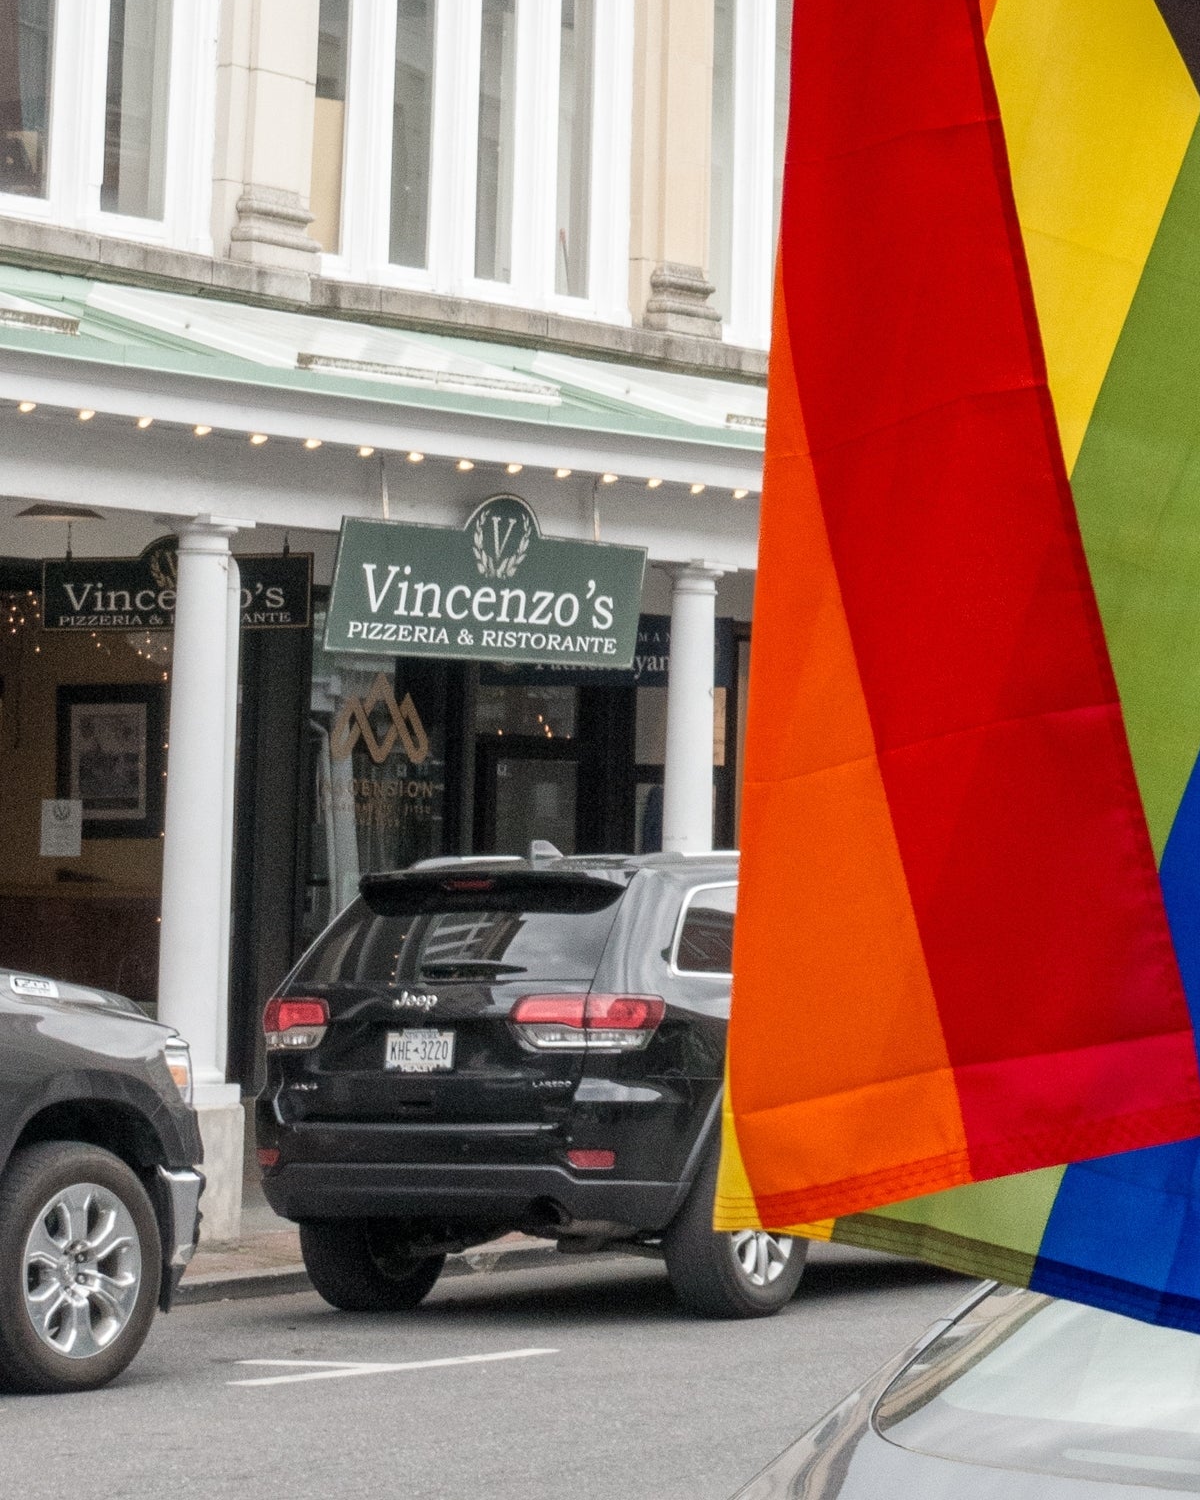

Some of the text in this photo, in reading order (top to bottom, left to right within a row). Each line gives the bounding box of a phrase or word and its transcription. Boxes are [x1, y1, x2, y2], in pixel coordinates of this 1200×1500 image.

[490, 515, 517, 560] V
[63, 582, 285, 612] Vinceo's
[362, 563, 614, 630] Vincenzo's
[59, 614, 143, 626] PIZZERIA
[149, 614, 164, 626] &
[347, 621, 617, 654] PIZZERIA & RISTORANTE
[393, 990, 438, 1013] Jeep
[390, 1040, 449, 1061] KHE 3220
